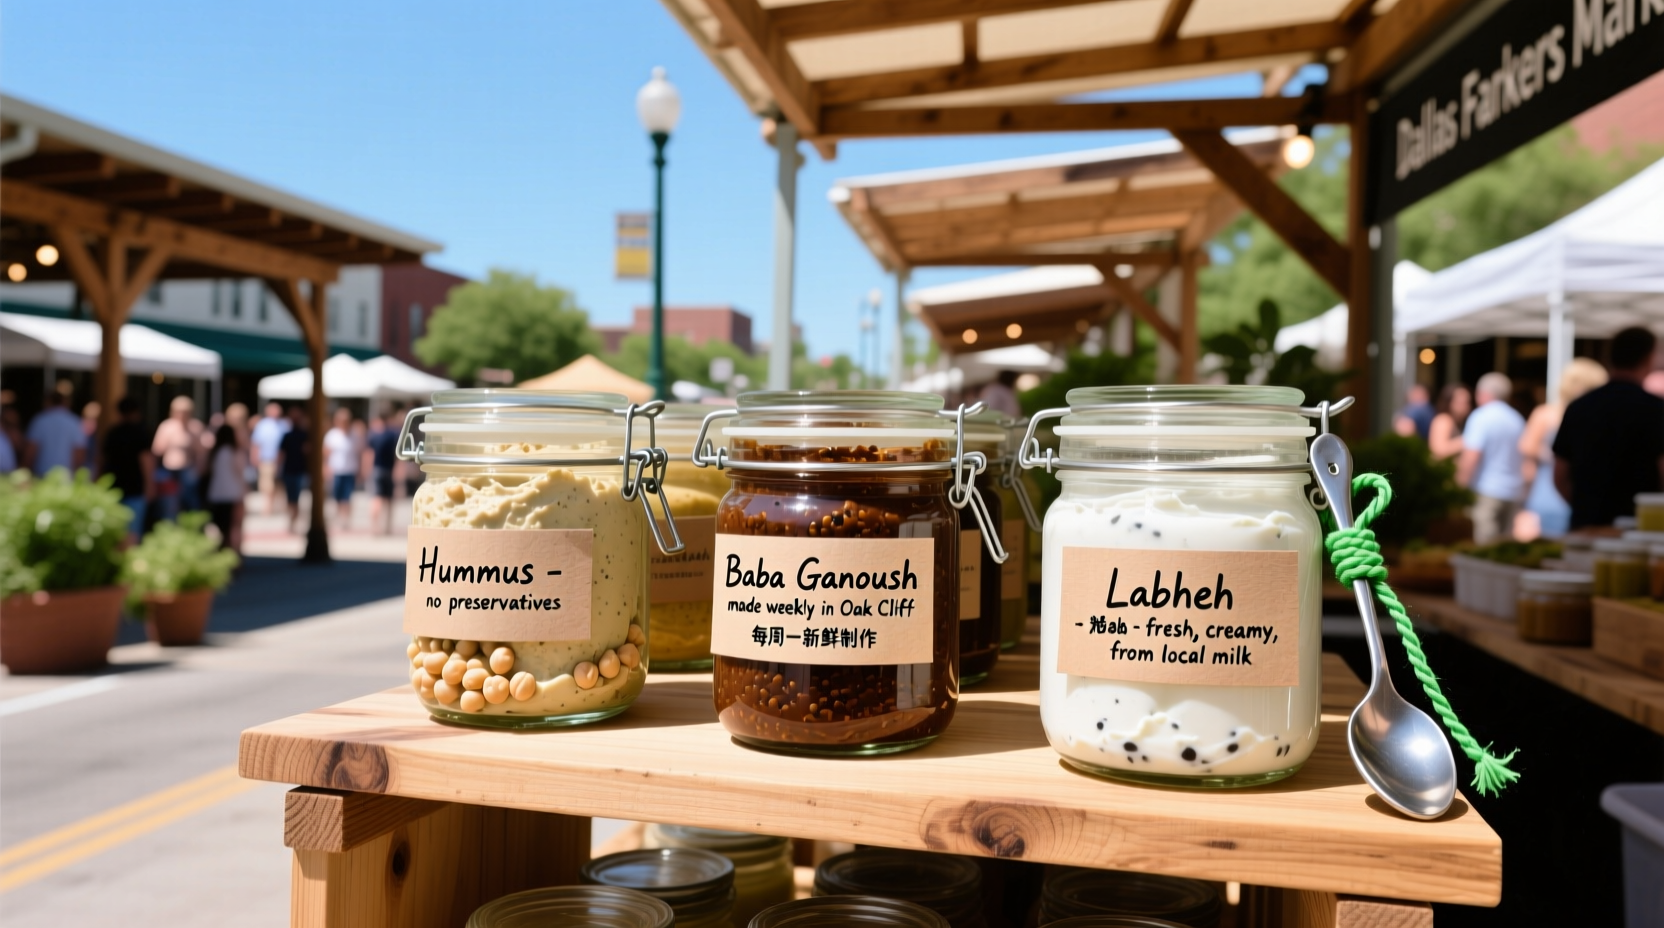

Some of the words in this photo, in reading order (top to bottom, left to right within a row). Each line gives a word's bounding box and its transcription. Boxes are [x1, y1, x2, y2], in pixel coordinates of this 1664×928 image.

[1396, 97, 1459, 180] Dallas
[1460, 24, 1566, 140] Farkers
[1572, 0, 1664, 68] Mar
[418, 545, 534, 585] Hummus
[725, 553, 786, 589] Baba
[796, 556, 918, 592] Ganoush
[1106, 567, 1234, 611] Labheh
[426, 596, 442, 609] no
[448, 593, 562, 616] preservatives
[727, 596, 762, 613] made
[766, 597, 815, 621] weekly
[821, 599, 834, 616] in
[840, 598, 873, 617] Oak
[877, 597, 915, 618] Cliff
[751, 624, 878, 649] 每周一新鲜制作
[1145, 616, 1199, 643] fresh,
[1205, 624, 1279, 645] creamy,
[1109, 639, 1154, 662] from
[1161, 643, 1206, 665] local
[1211, 645, 1253, 666] milk
